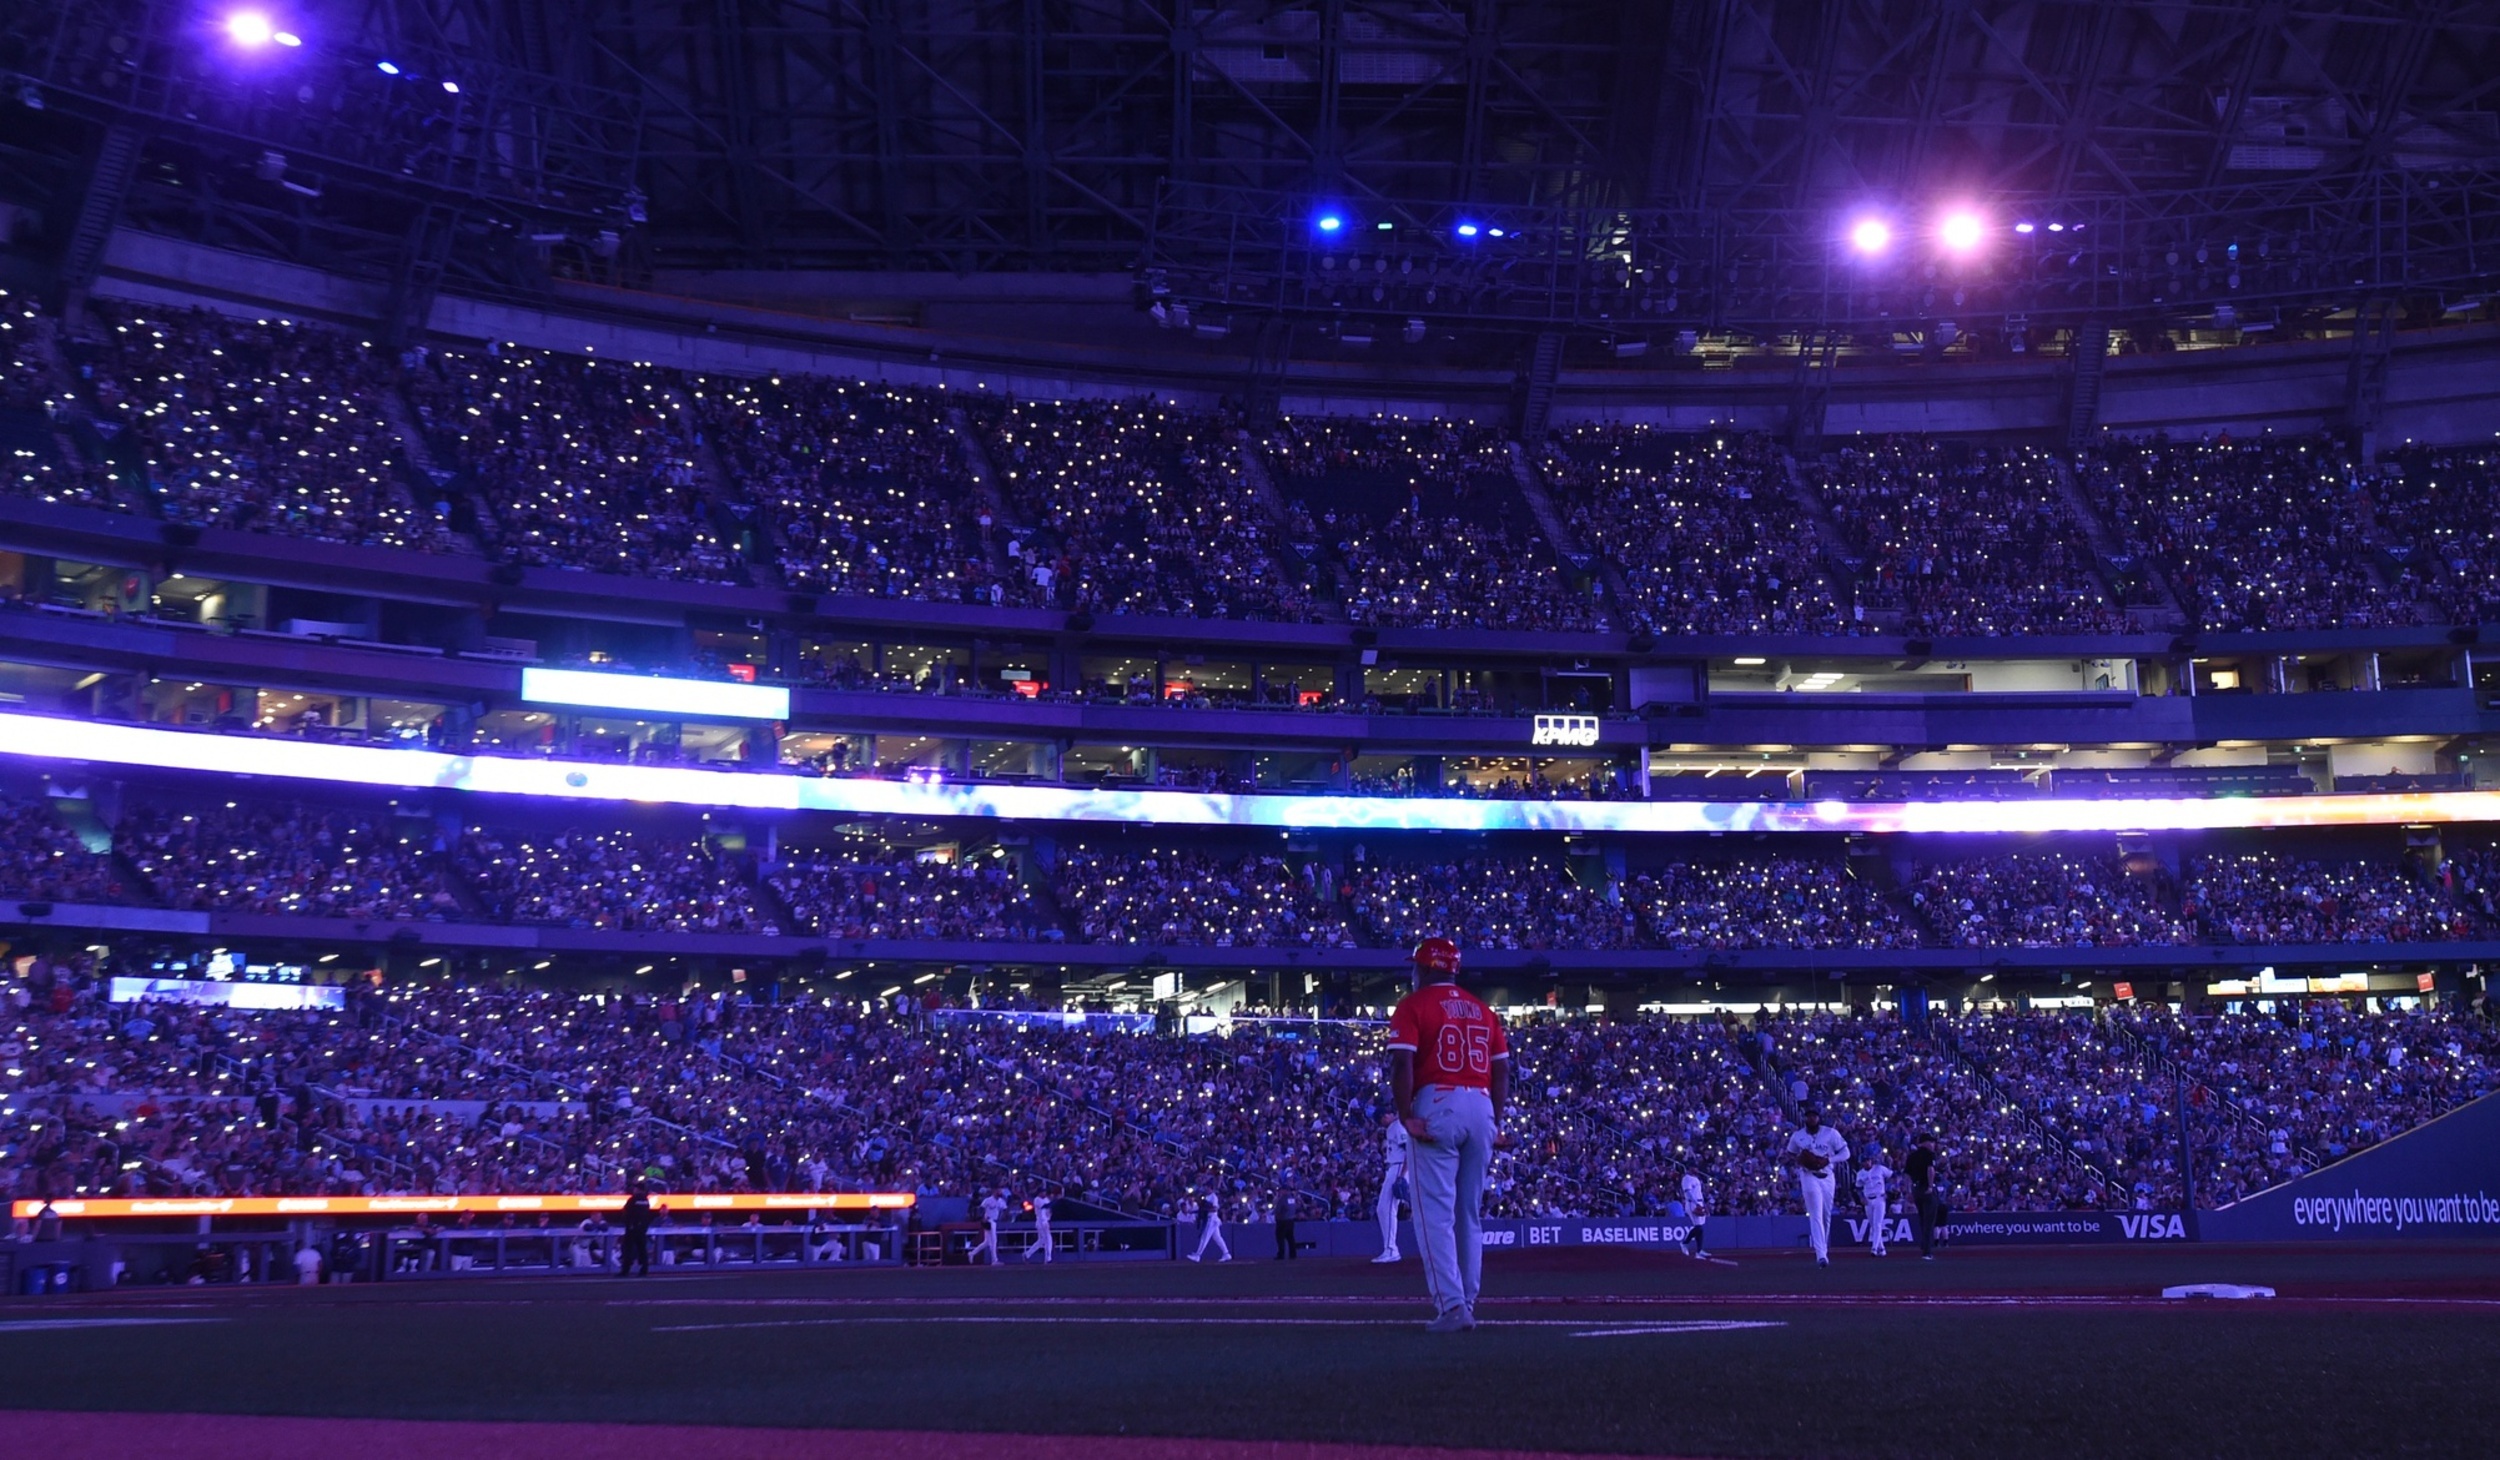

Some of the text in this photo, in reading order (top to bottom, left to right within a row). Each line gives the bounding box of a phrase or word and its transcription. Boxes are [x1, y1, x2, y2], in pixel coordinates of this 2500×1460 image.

[1532, 724, 1597, 746] KPMG
[1439, 999, 1484, 1021] YOUNG
[1437, 1024, 1490, 1073] 85
[2294, 1188, 2500, 1232] everywhere you want to be
[1482, 1226, 1562, 1245] ore BET
[1581, 1227, 1659, 1243] BASELINE
[1949, 1220, 2100, 1236] rywhere you want to be
[2114, 1214, 2186, 1238] VISA
